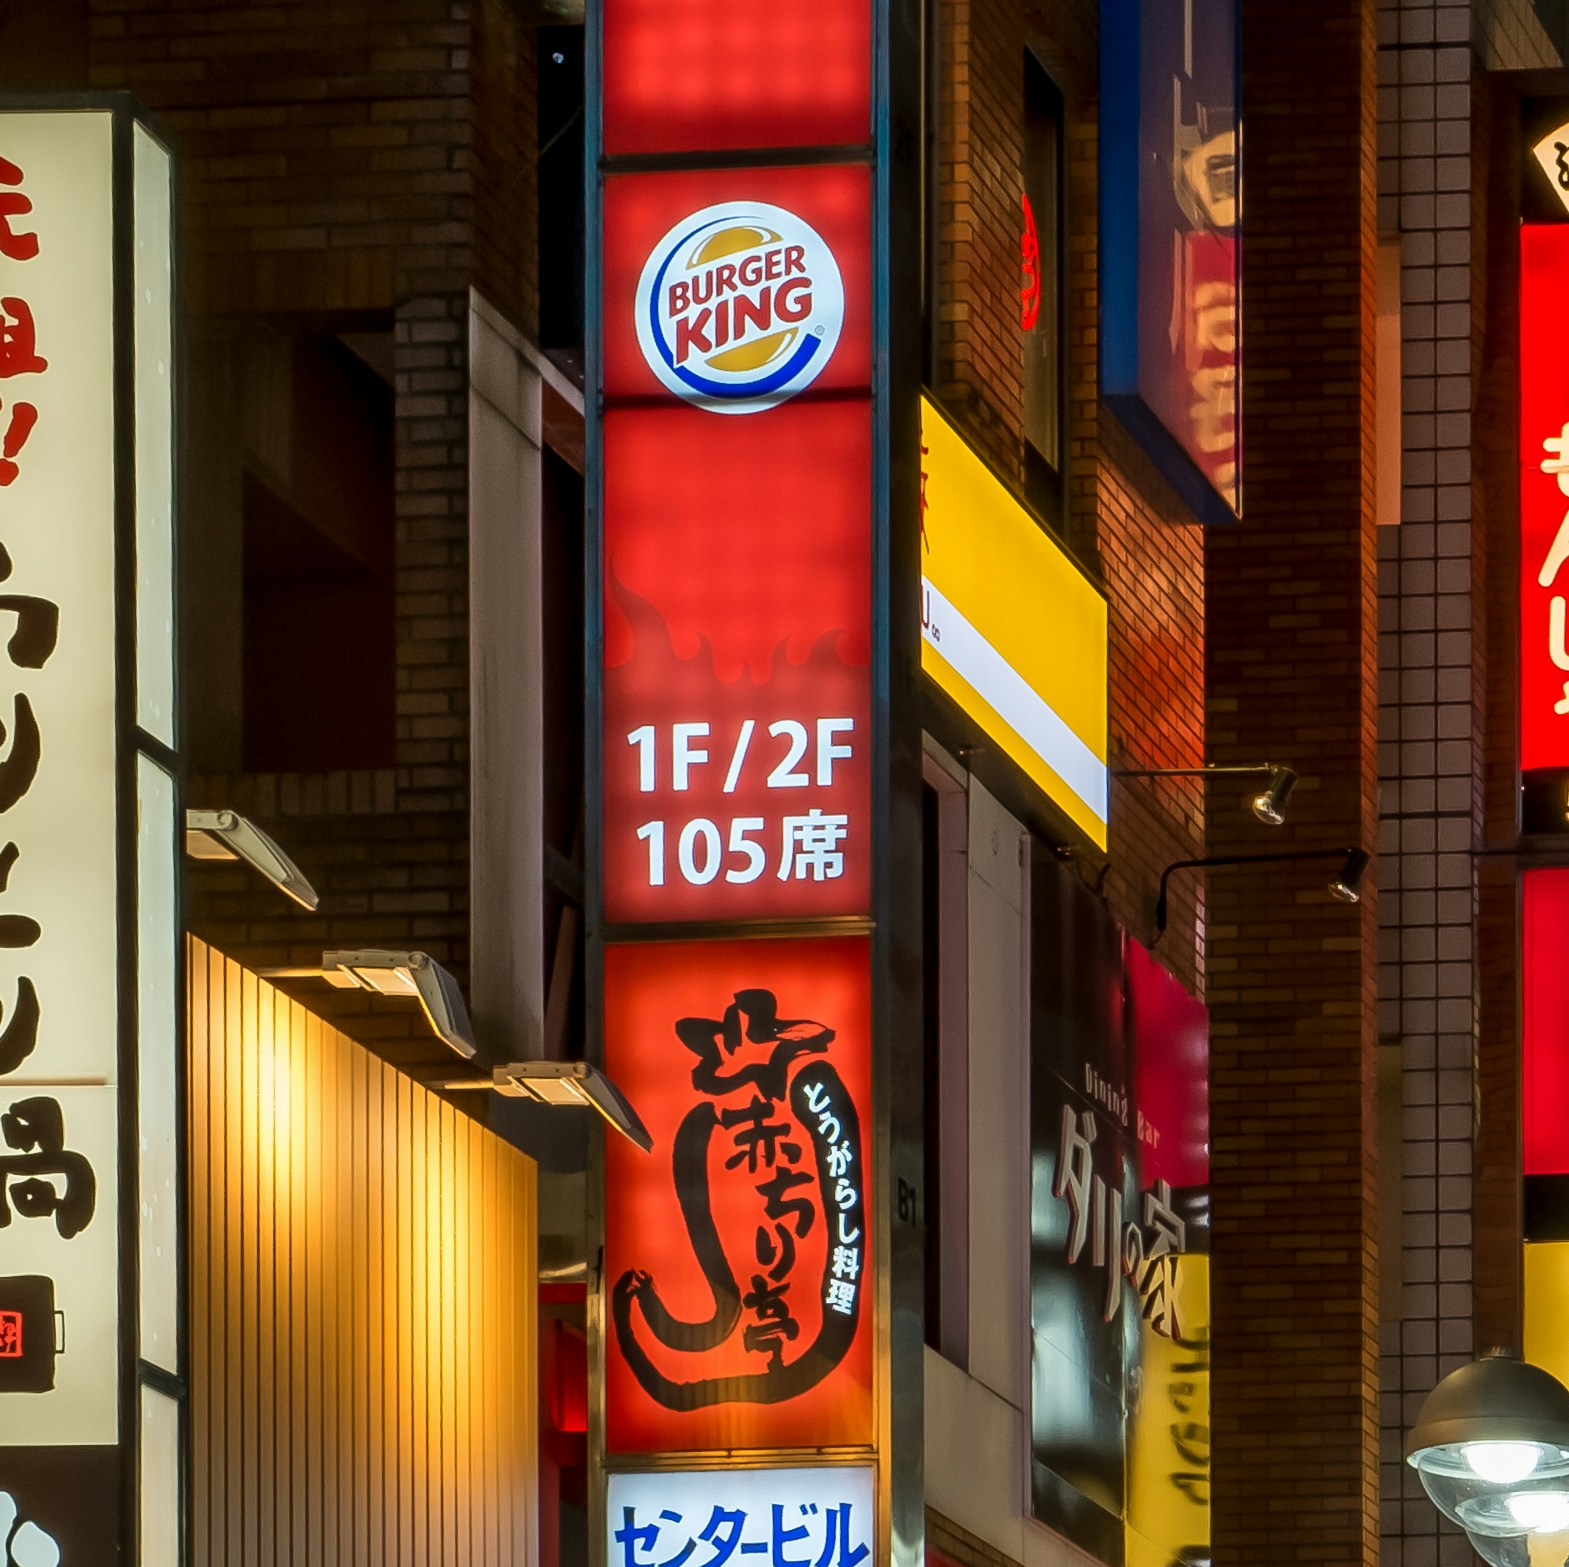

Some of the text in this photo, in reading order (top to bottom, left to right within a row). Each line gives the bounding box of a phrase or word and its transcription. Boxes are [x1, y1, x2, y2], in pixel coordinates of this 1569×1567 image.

[667, 245, 806, 320] BURGER
[673, 278, 814, 369] KING
[636, 809, 848, 886] 105席
[803, 1082, 860, 1316] とうがらし料理
